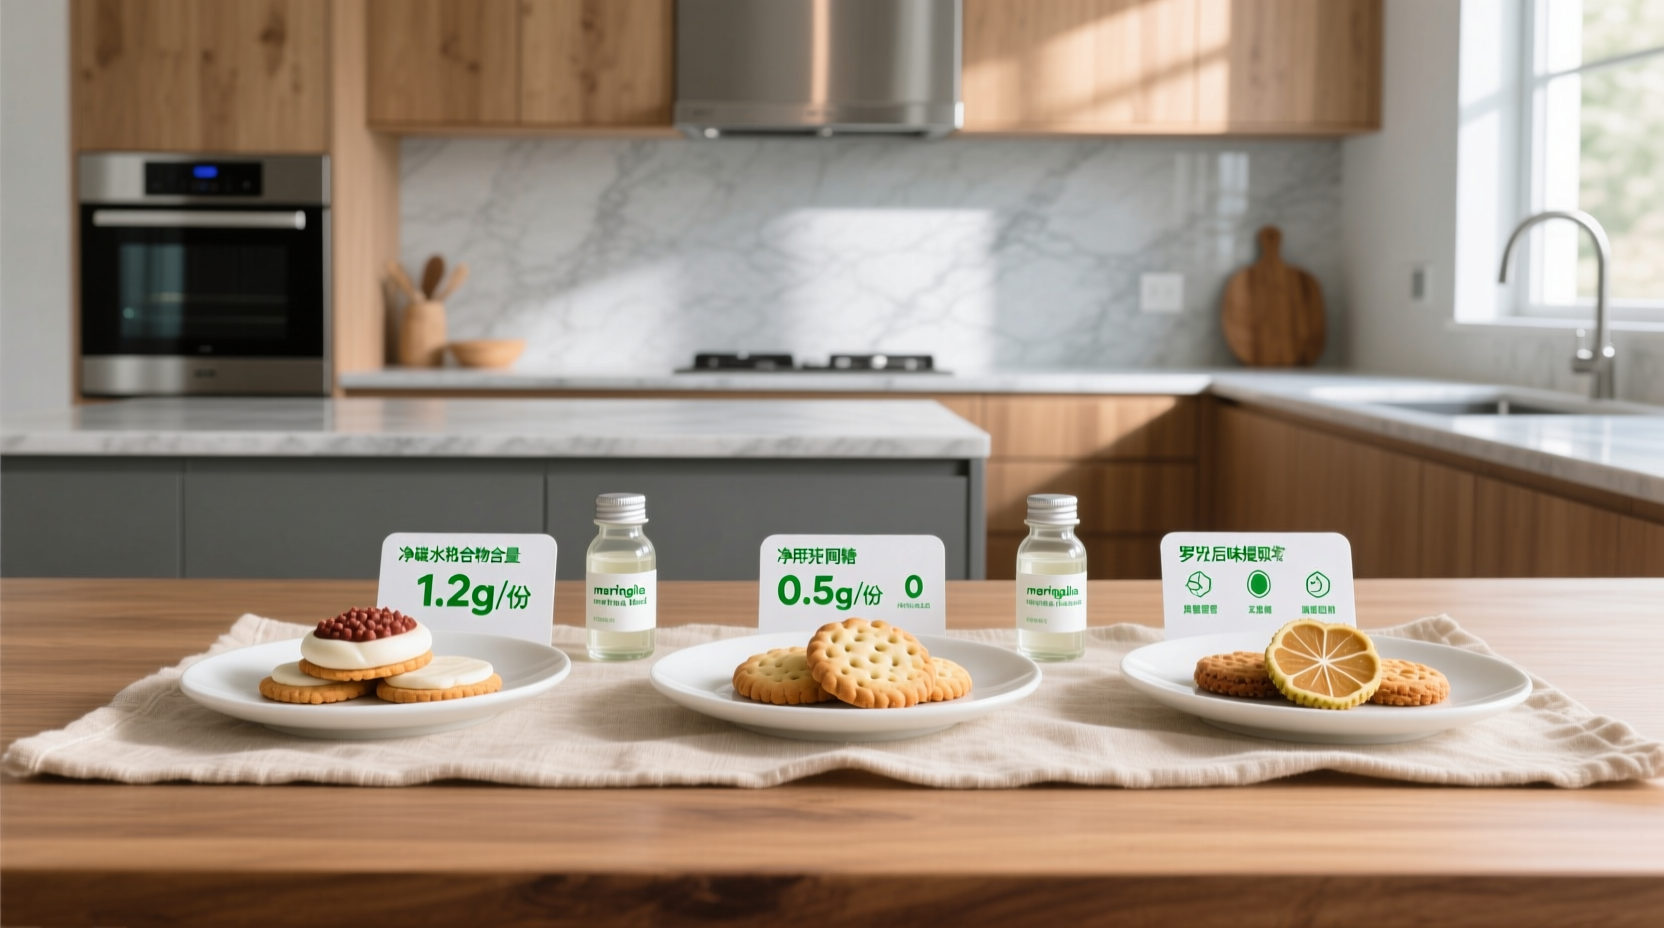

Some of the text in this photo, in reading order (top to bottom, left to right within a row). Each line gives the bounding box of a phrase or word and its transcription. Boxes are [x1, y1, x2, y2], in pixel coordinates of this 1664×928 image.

[417, 573, 531, 616] 1.2g/份
[777, 574, 883, 611] 0.5g/份
[904, 574, 923, 599] 0
